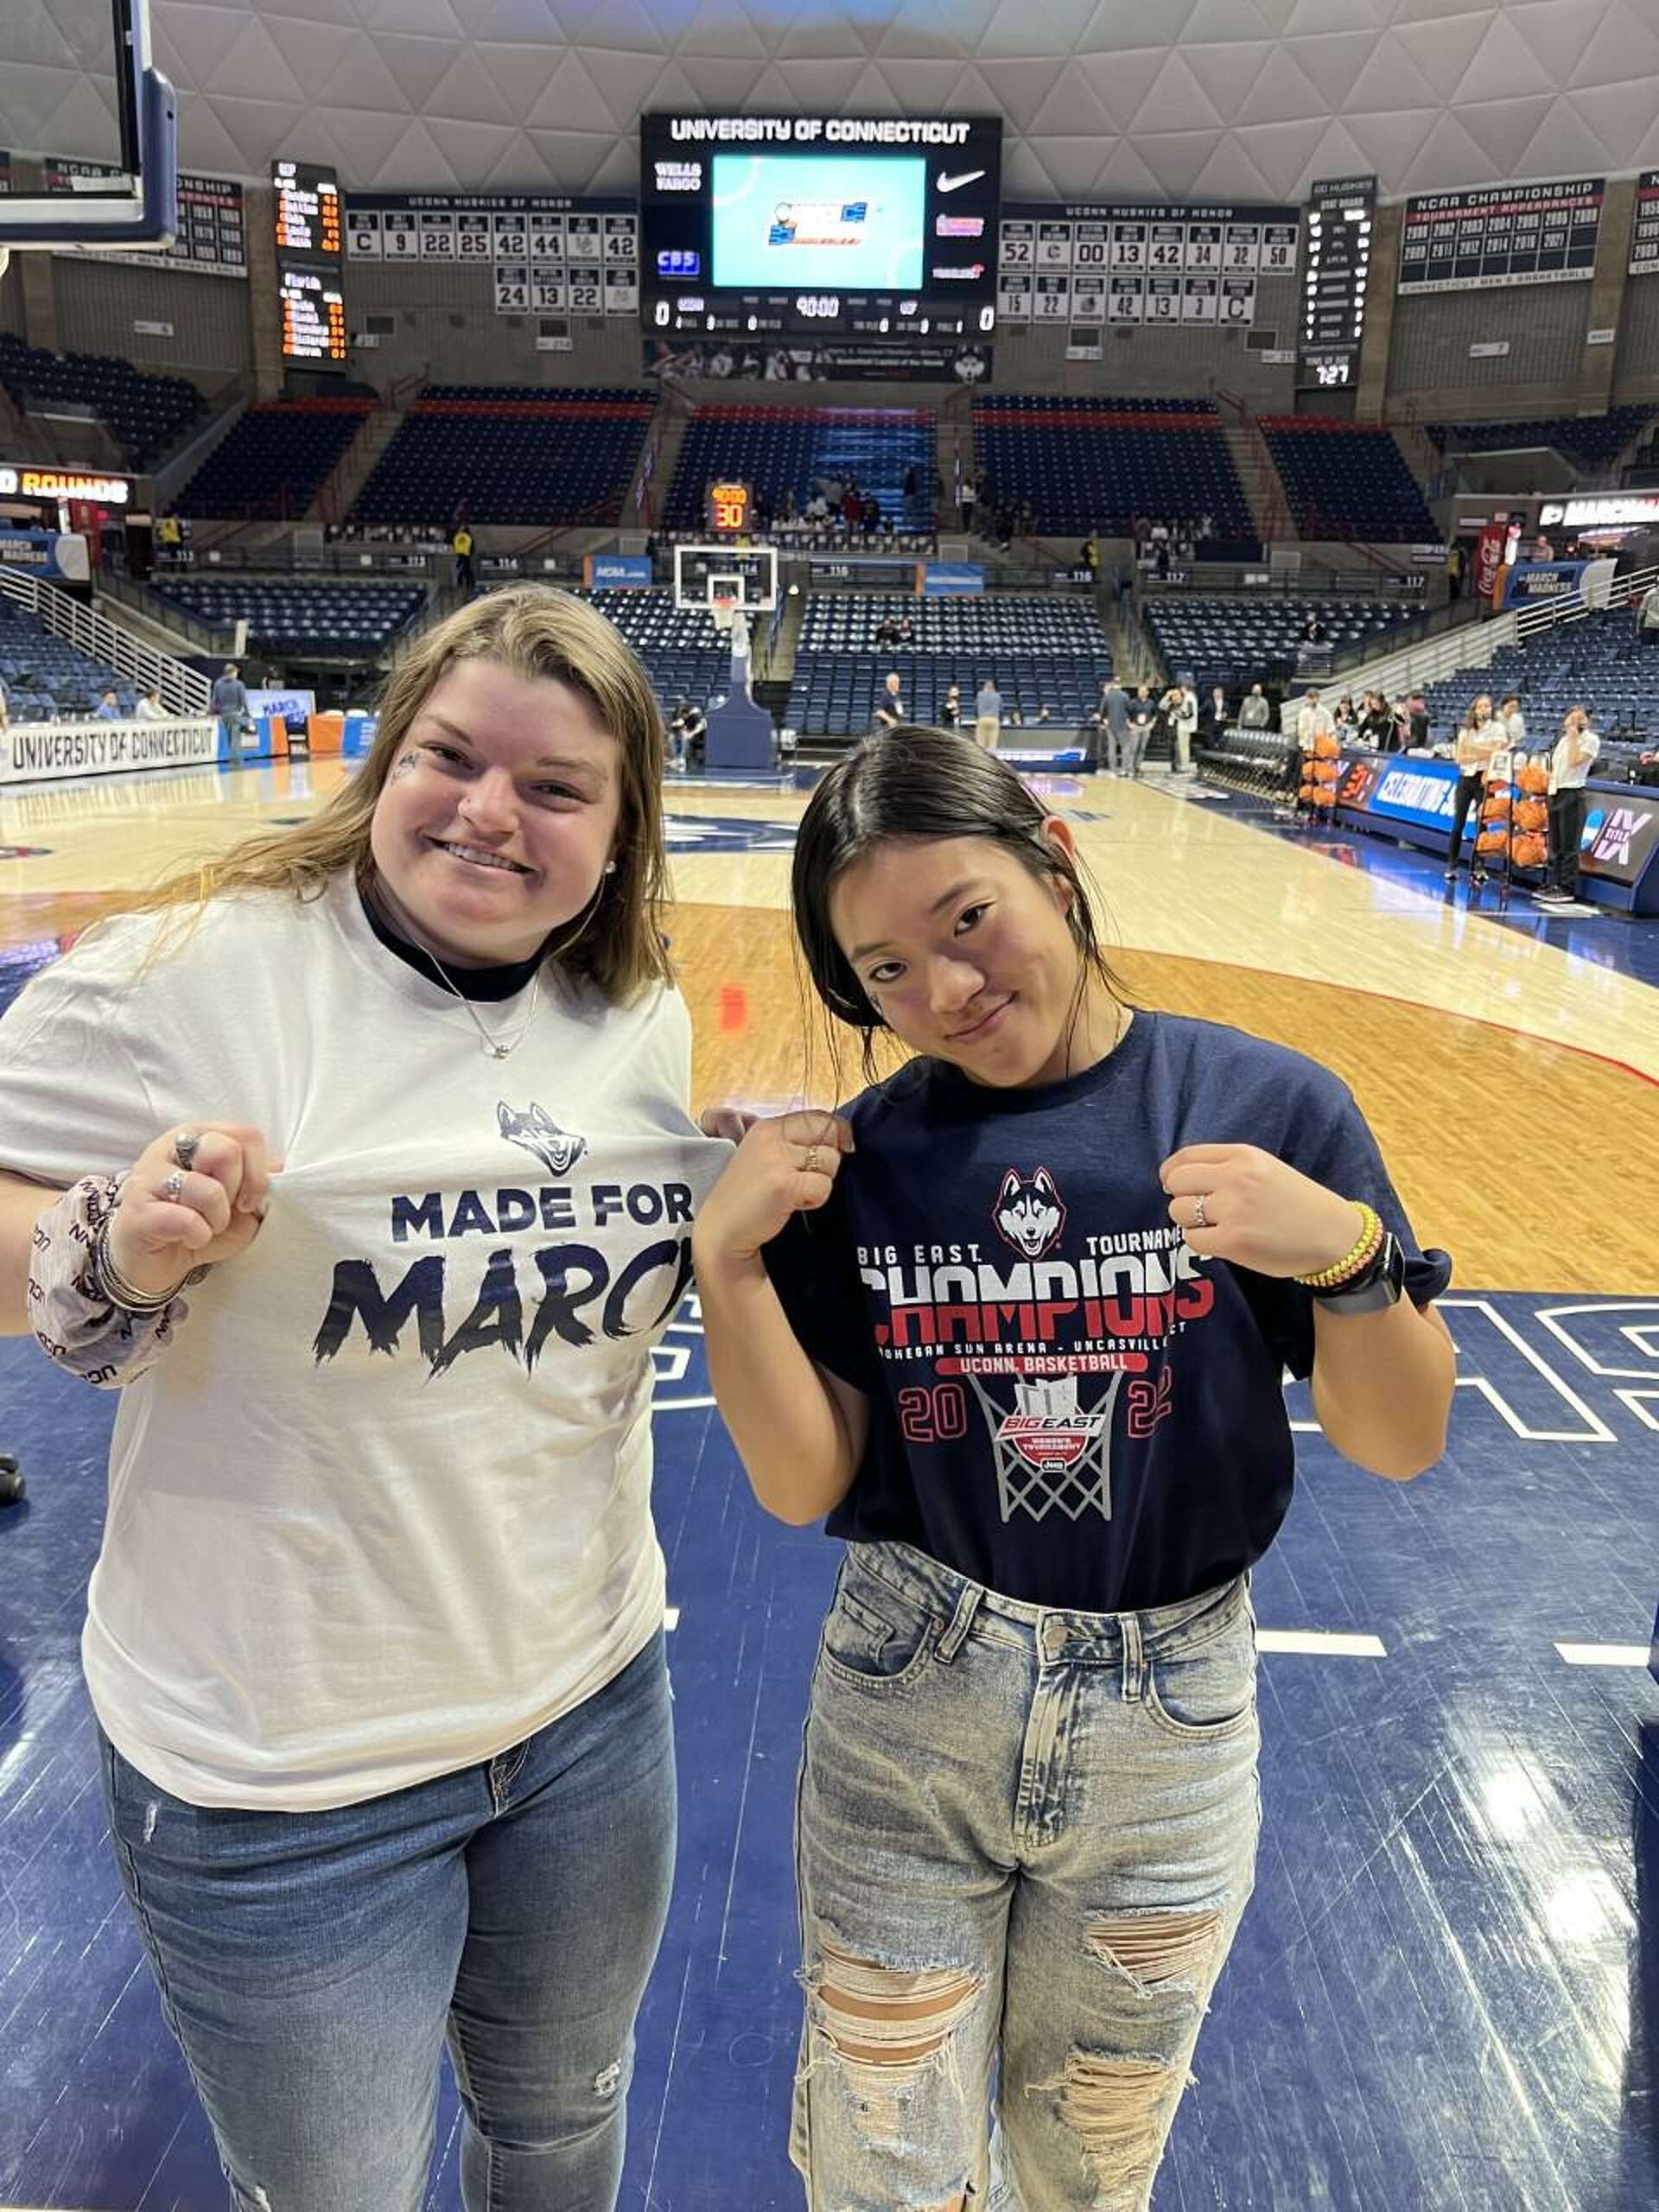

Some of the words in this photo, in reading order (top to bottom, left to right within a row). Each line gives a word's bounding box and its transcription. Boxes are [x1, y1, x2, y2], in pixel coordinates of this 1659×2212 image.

[671, 118, 791, 140] UNIVERSITY
[794, 120, 823, 140] OF
[825, 119, 970, 144] CONNECTICUT
[1417, 195, 1460, 211] NCAA
[1467, 182, 1593, 207] CHAMPIONSHIP
[356, 234, 372, 251] C
[425, 234, 450, 251] 22
[461, 235, 487, 252] 25
[499, 235, 524, 252] 42
[535, 236, 560, 253] 44
[608, 238, 633, 255] 42
[1005, 243, 1029, 261] 52
[1079, 245, 1103, 262] 00
[1118, 245, 1139, 263] 13
[1154, 245, 1179, 263] 42
[1270, 248, 1287, 264] 50
[499, 288, 524, 305] 24
[538, 288, 557, 305] 13
[573, 289, 596, 306] 22
[655, 300, 671, 326] 0
[1228, 297, 1244, 318] C
[979, 305, 995, 331] 0
[22, 472, 129, 504] ROUNDS
[715, 504, 743, 528] 30
[13, 734, 107, 770] UNIVERSITY
[110, 733, 127, 760] OF
[131, 727, 213, 760] CONNECTICUT
[391, 1186, 577, 1243] MADE
[591, 1182, 694, 1227] FOR
[856, 1246, 897, 1266] BIG
[955, 1343, 985, 1355] SUN
[995, 1341, 1047, 1355] ARENA
[1024, 1352, 1128, 1372] BASKETBALL
[899, 1384, 968, 1443] 20
